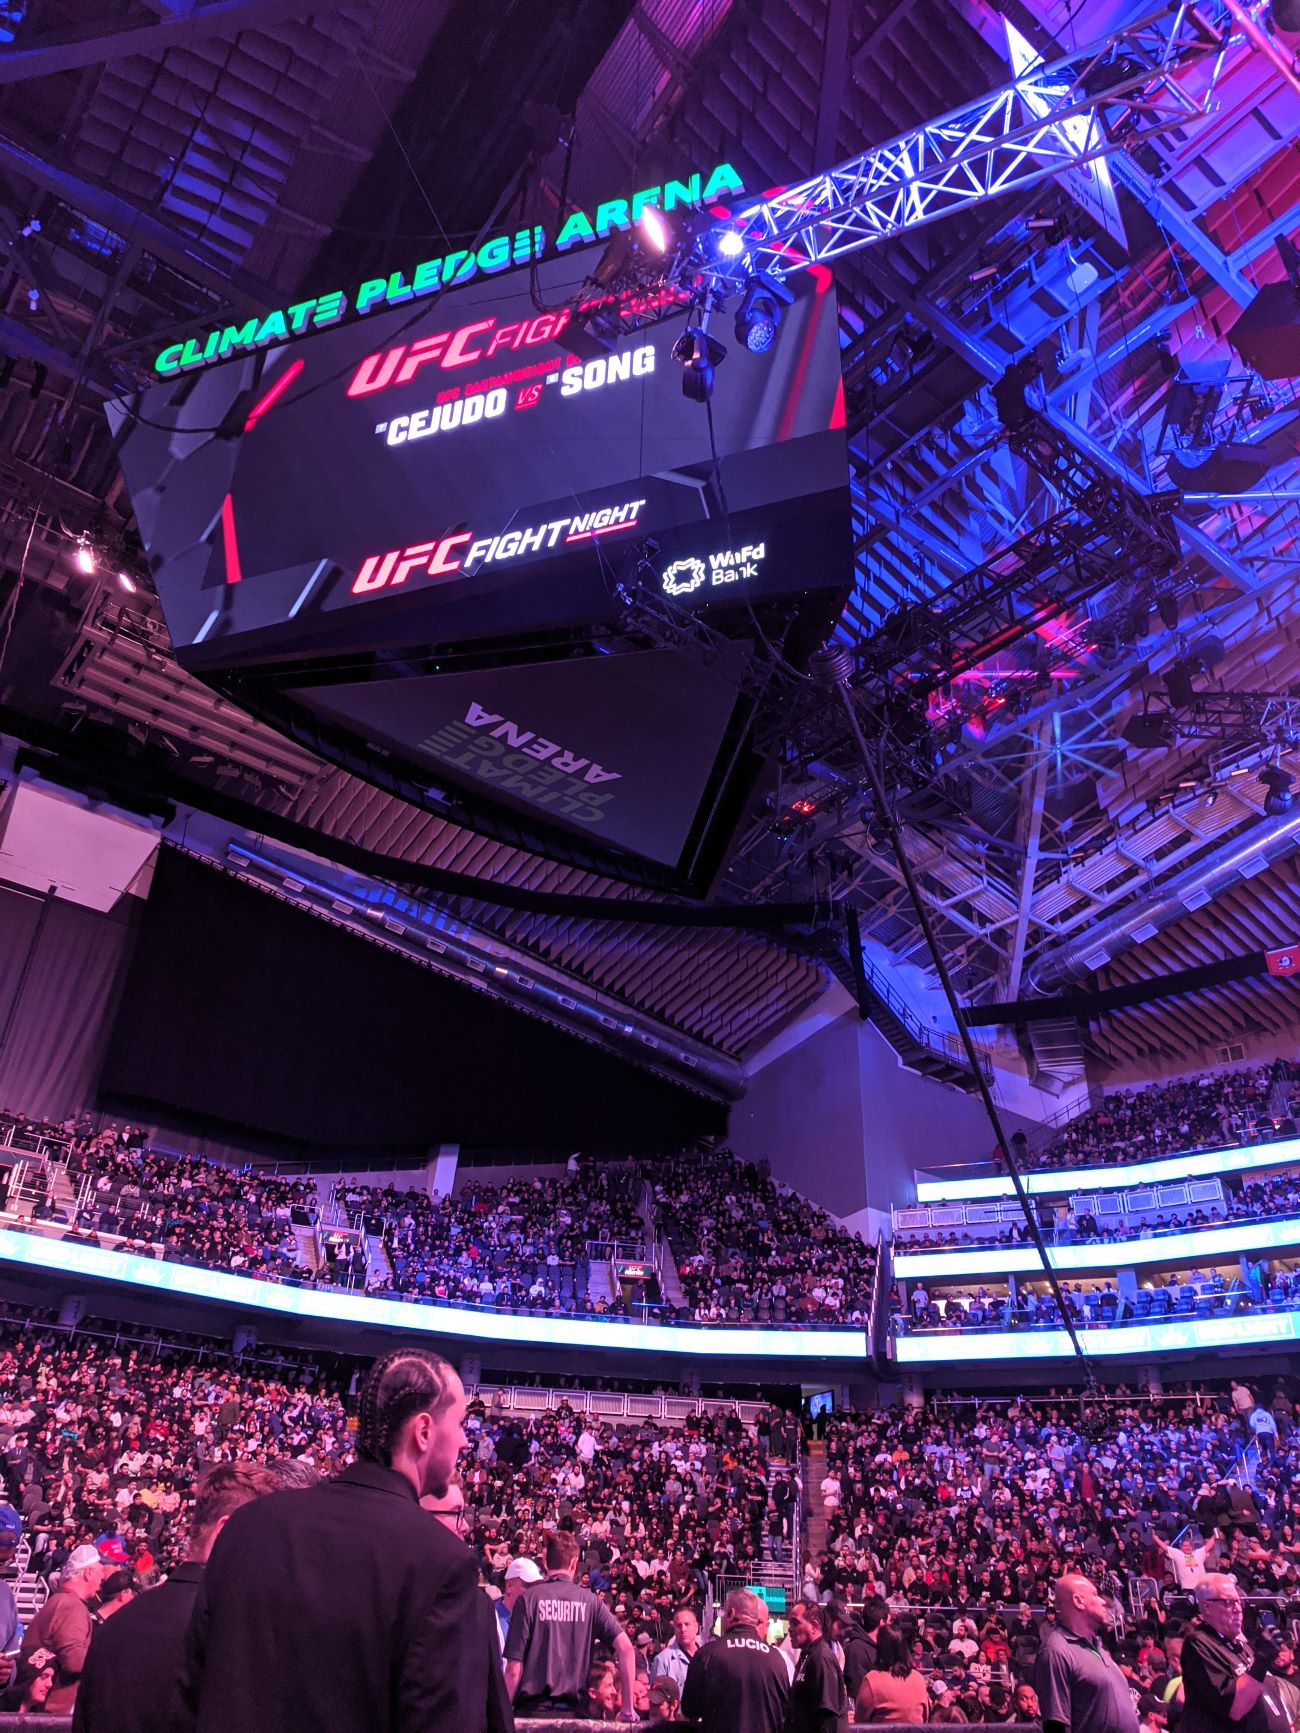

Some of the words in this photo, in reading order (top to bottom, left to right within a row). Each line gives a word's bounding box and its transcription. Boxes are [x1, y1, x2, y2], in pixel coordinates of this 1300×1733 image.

[155, 290, 346, 375] CLIMATE
[355, 225, 545, 313] PLEDGE
[555, 163, 744, 249] ARENA
[347, 317, 496, 397] UFC
[560, 345, 656, 396] SONG
[386, 388, 507, 446] CEJUDO
[517, 384, 543, 404] VS
[352, 532, 473, 593] UFC
[464, 519, 571, 567] FIGHT
[568, 500, 646, 534] NIGHT
[712, 562, 758, 585] Bank
[464, 701, 623, 783] ARENA
[539, 1599, 587, 1622] SECURITY
[727, 1638, 770, 1654] LUCIO
